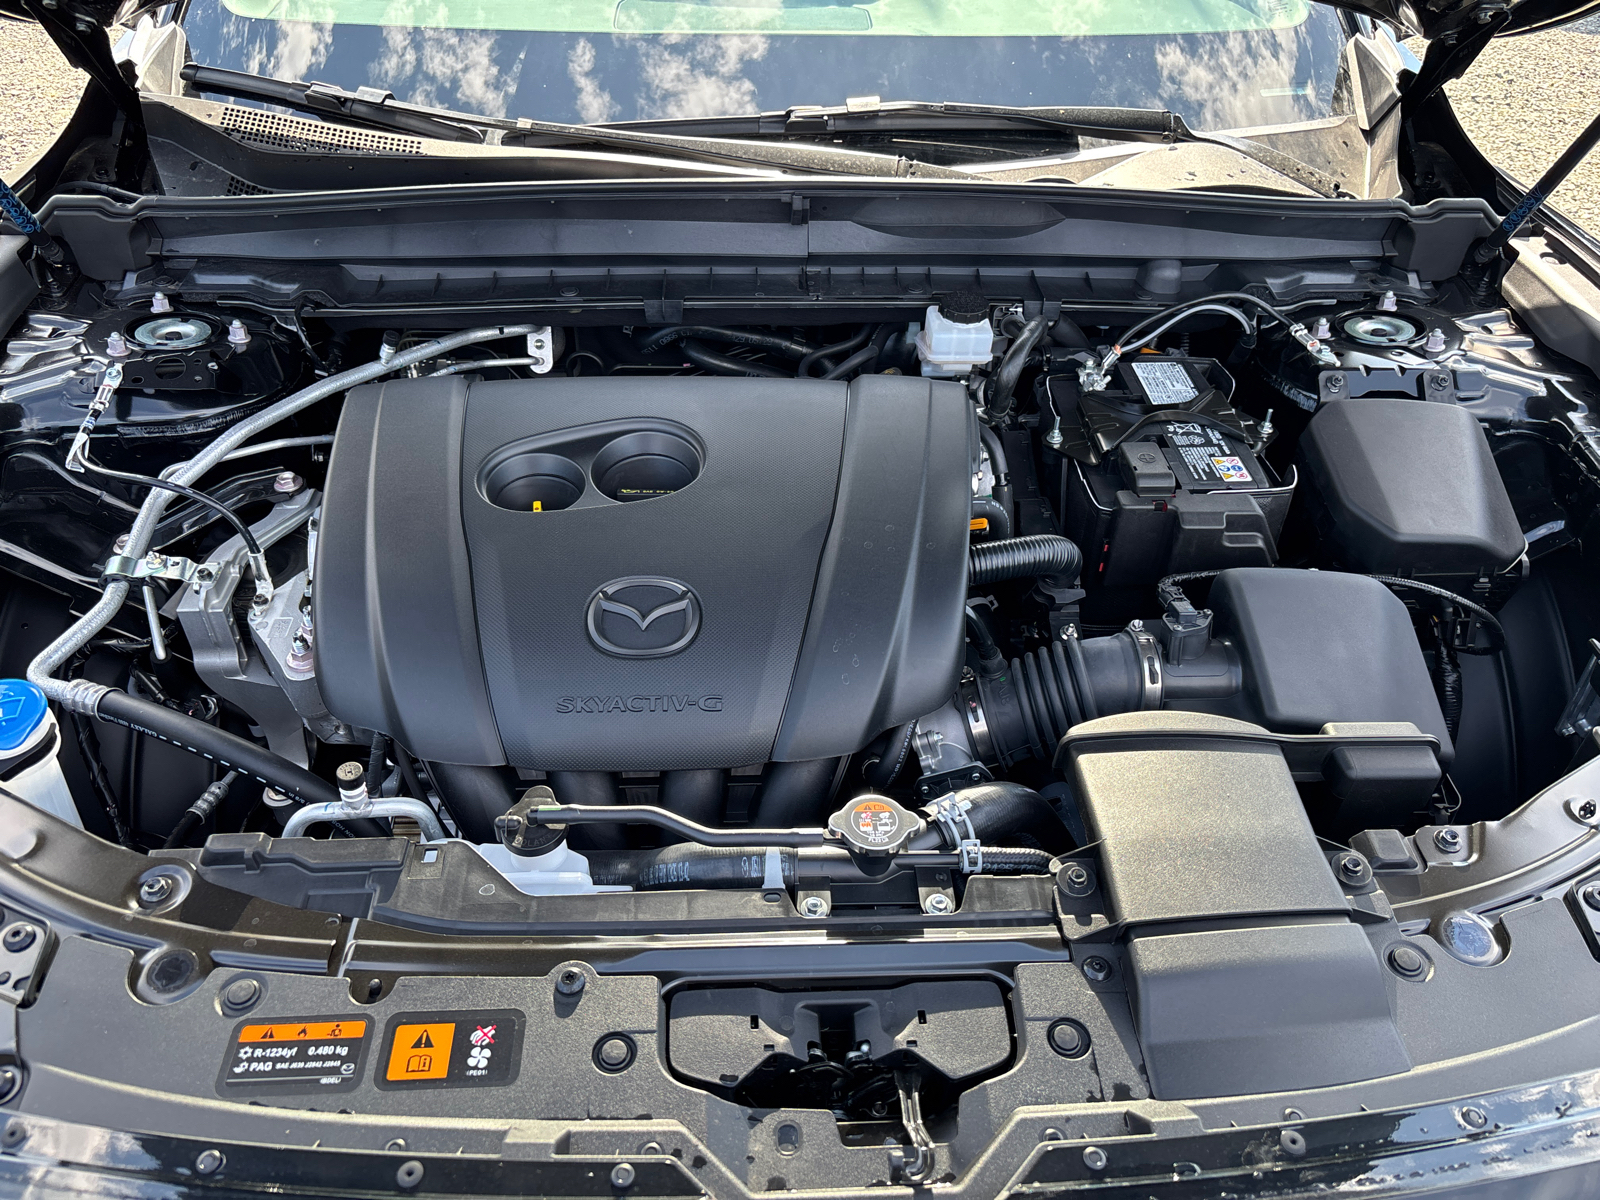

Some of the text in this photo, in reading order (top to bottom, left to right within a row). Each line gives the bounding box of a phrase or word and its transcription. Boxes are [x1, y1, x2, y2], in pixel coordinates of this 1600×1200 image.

[556, 694, 723, 714] SKYACTIV-G
[130, 723, 157, 737] GALAXY
[253, 1045, 349, 1059] R-1234yf 0.480 kg
[249, 1061, 273, 1072] PAG
[275, 1061, 289, 1070] SAE
